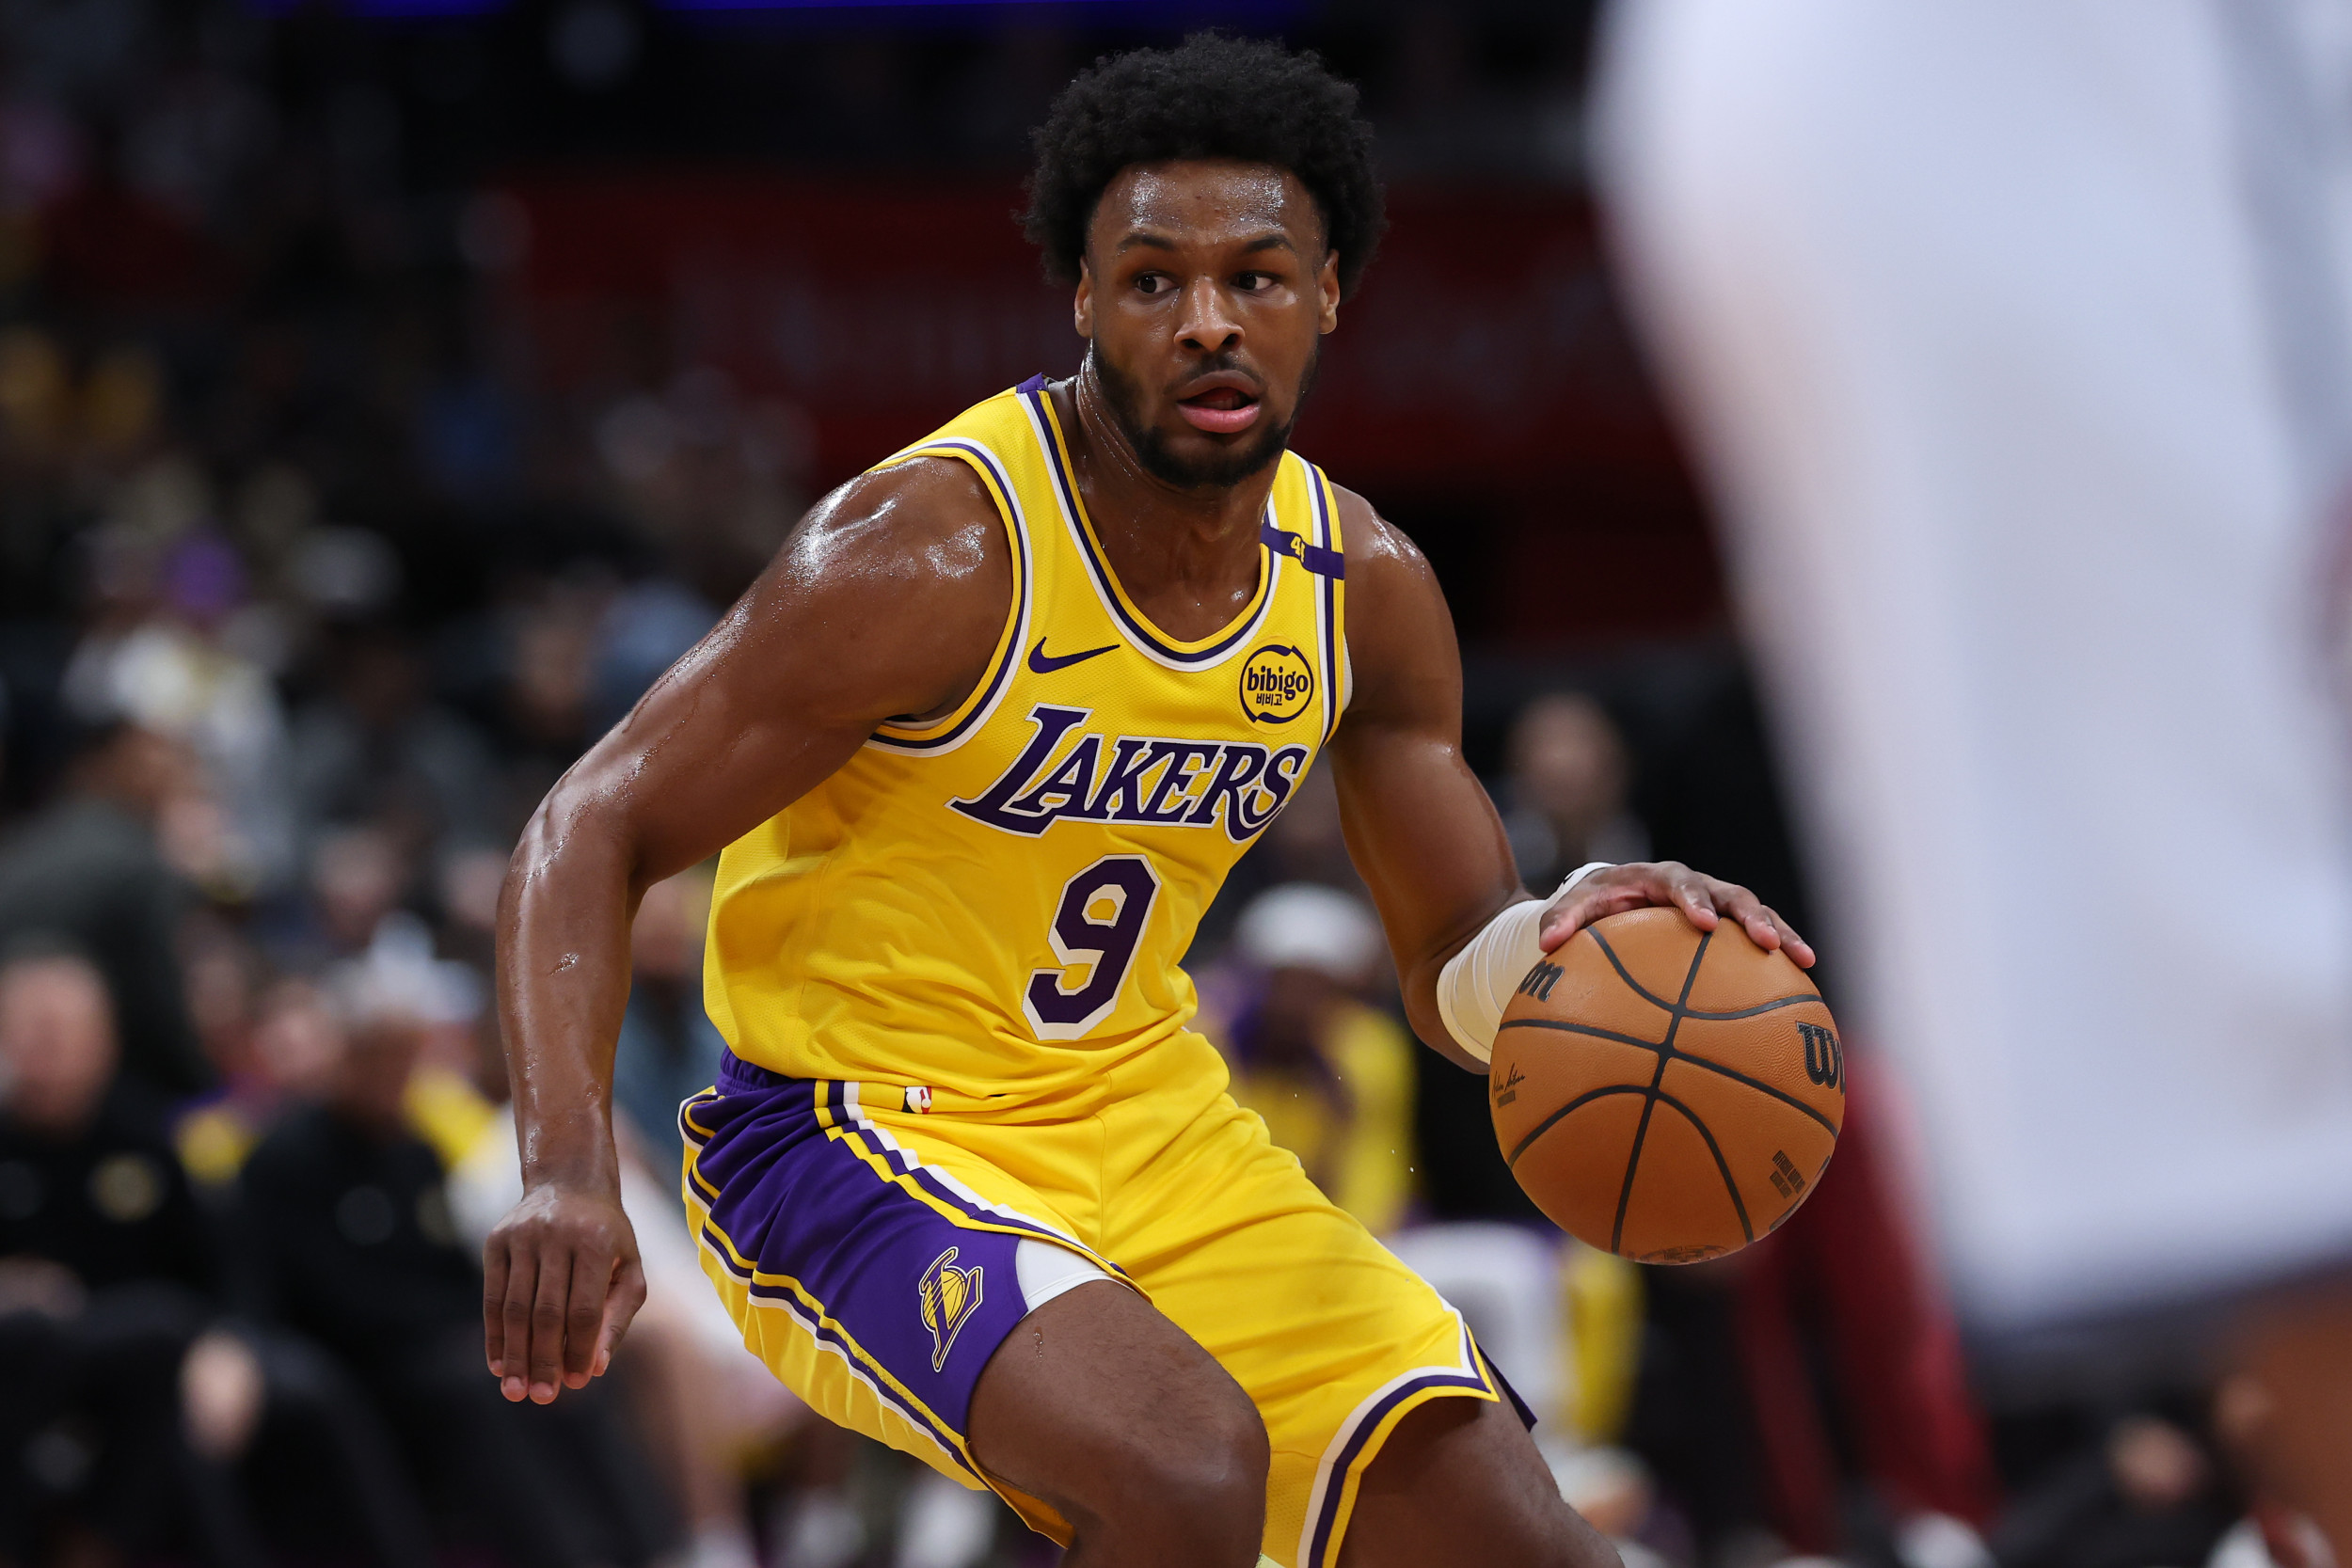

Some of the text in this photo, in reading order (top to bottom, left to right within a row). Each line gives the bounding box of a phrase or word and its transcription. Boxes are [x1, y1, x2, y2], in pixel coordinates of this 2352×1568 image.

[1247, 665, 1309, 701] bibigo
[1256, 693, 1282, 706] 비비고
[944, 702, 1311, 844] LAKERS
[1022, 853, 1162, 1041] 9
